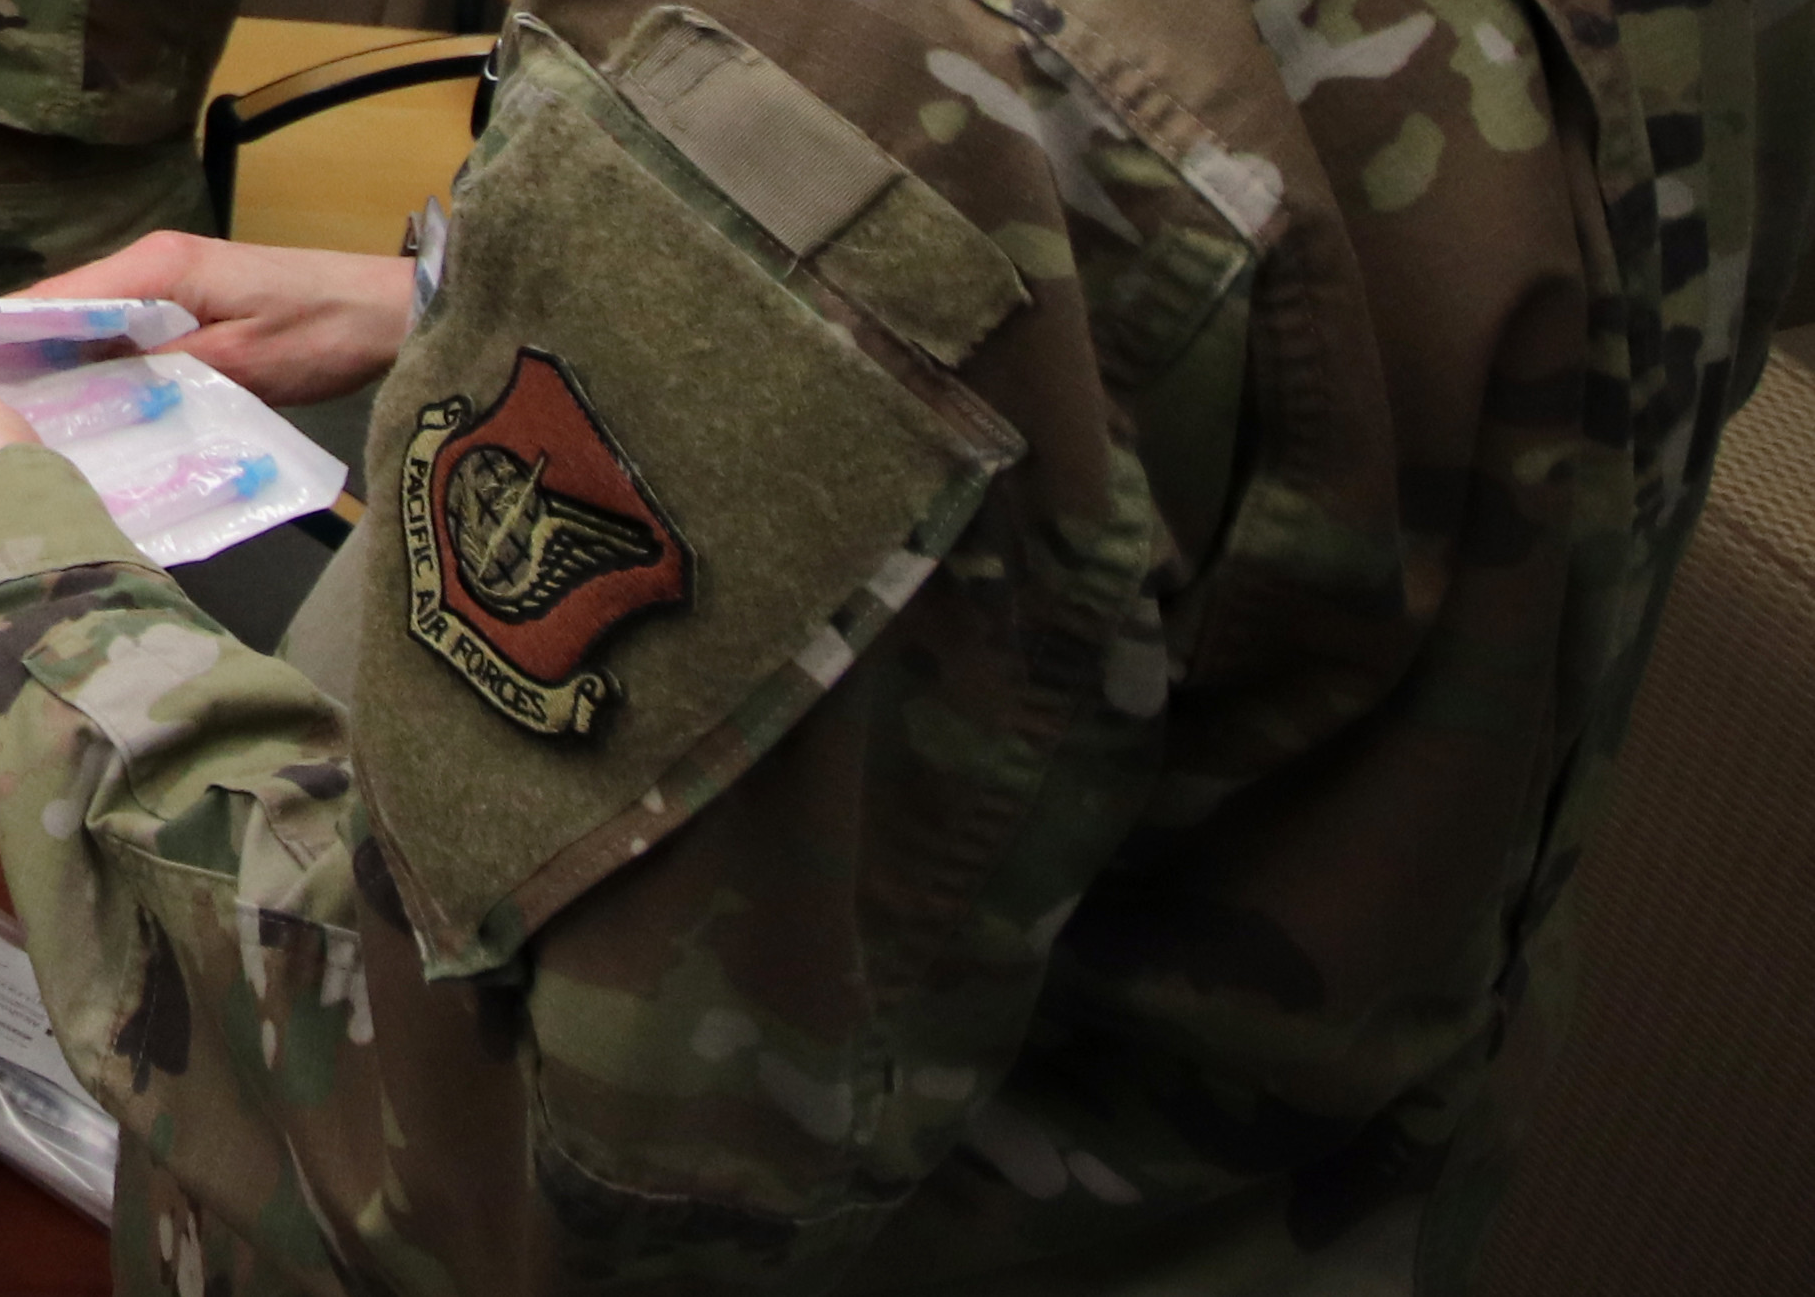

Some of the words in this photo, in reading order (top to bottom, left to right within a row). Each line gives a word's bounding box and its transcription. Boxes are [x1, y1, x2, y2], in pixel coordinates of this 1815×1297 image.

[405, 458, 435, 578] PACIFIC
[416, 590, 449, 643] AIR
[451, 633, 549, 724] FORCES
